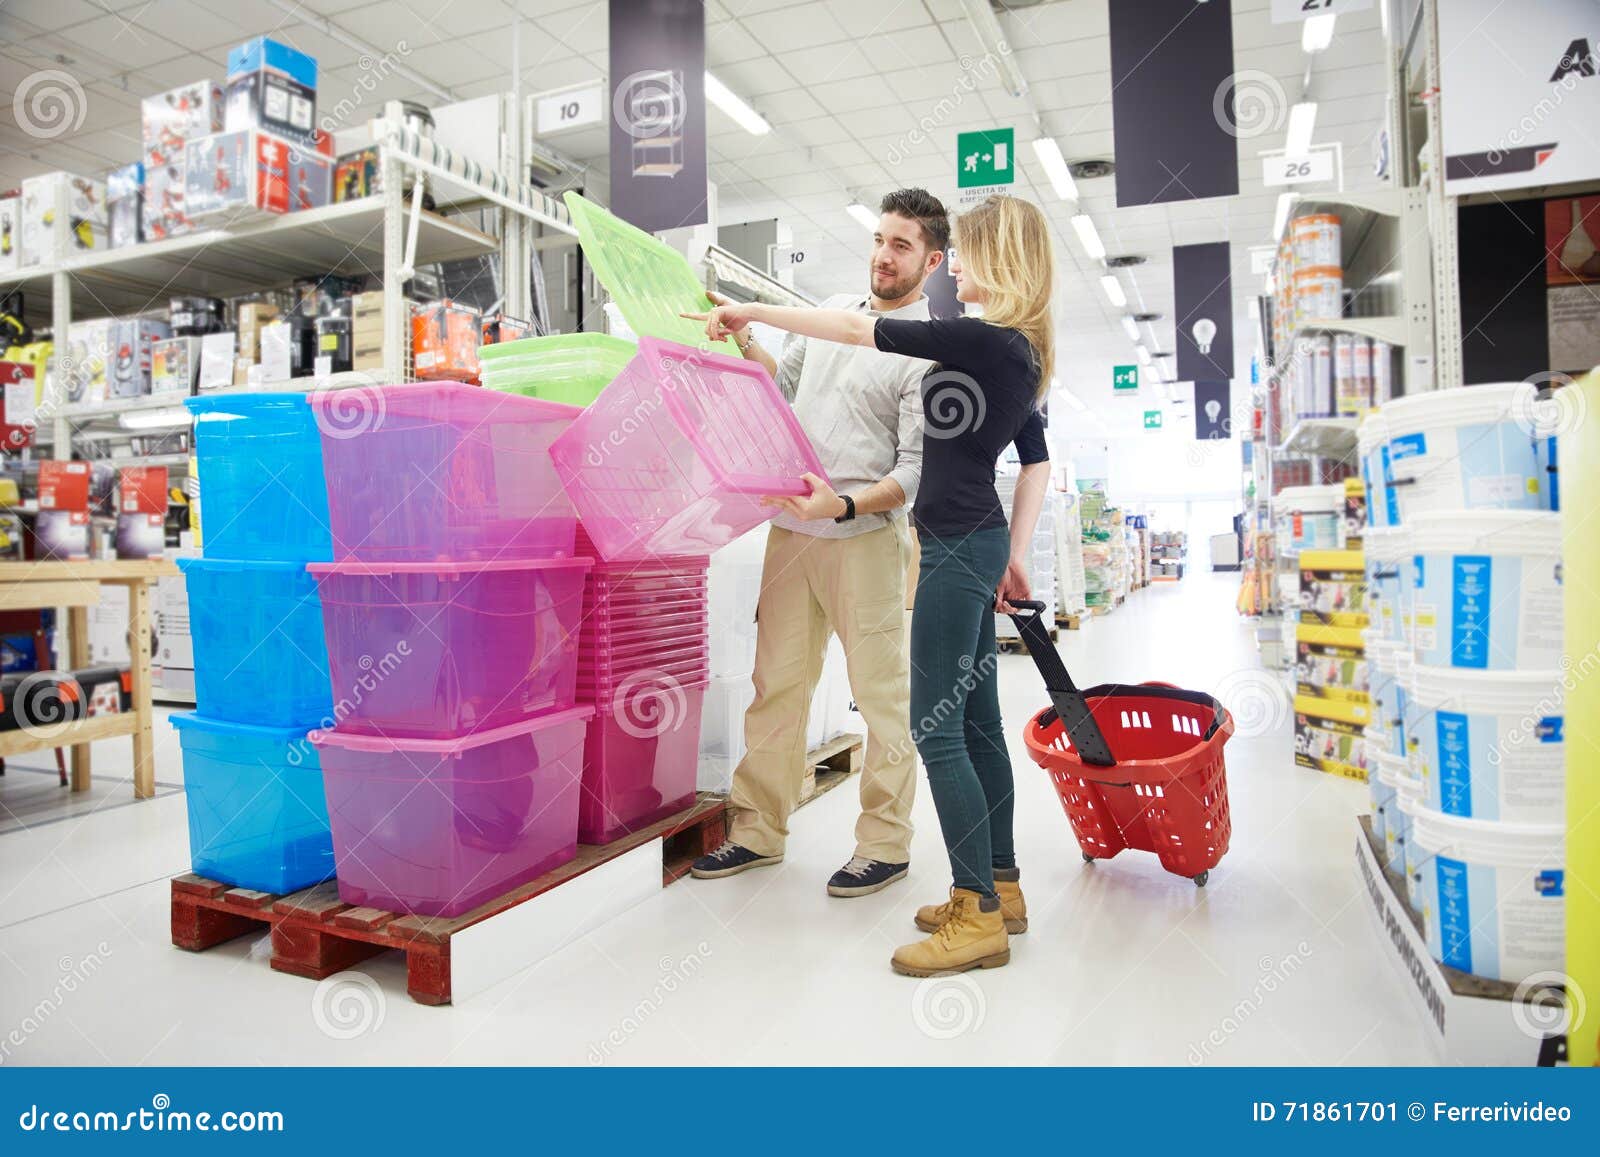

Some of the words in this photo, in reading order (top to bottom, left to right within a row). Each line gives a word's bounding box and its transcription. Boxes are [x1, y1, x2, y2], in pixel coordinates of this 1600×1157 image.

[1549, 38, 1600, 82] A
[560, 102, 580, 120] 10
[1285, 162, 1311, 178] 26
[965, 187, 996, 196] USCITA
[790, 252, 805, 264] 10
